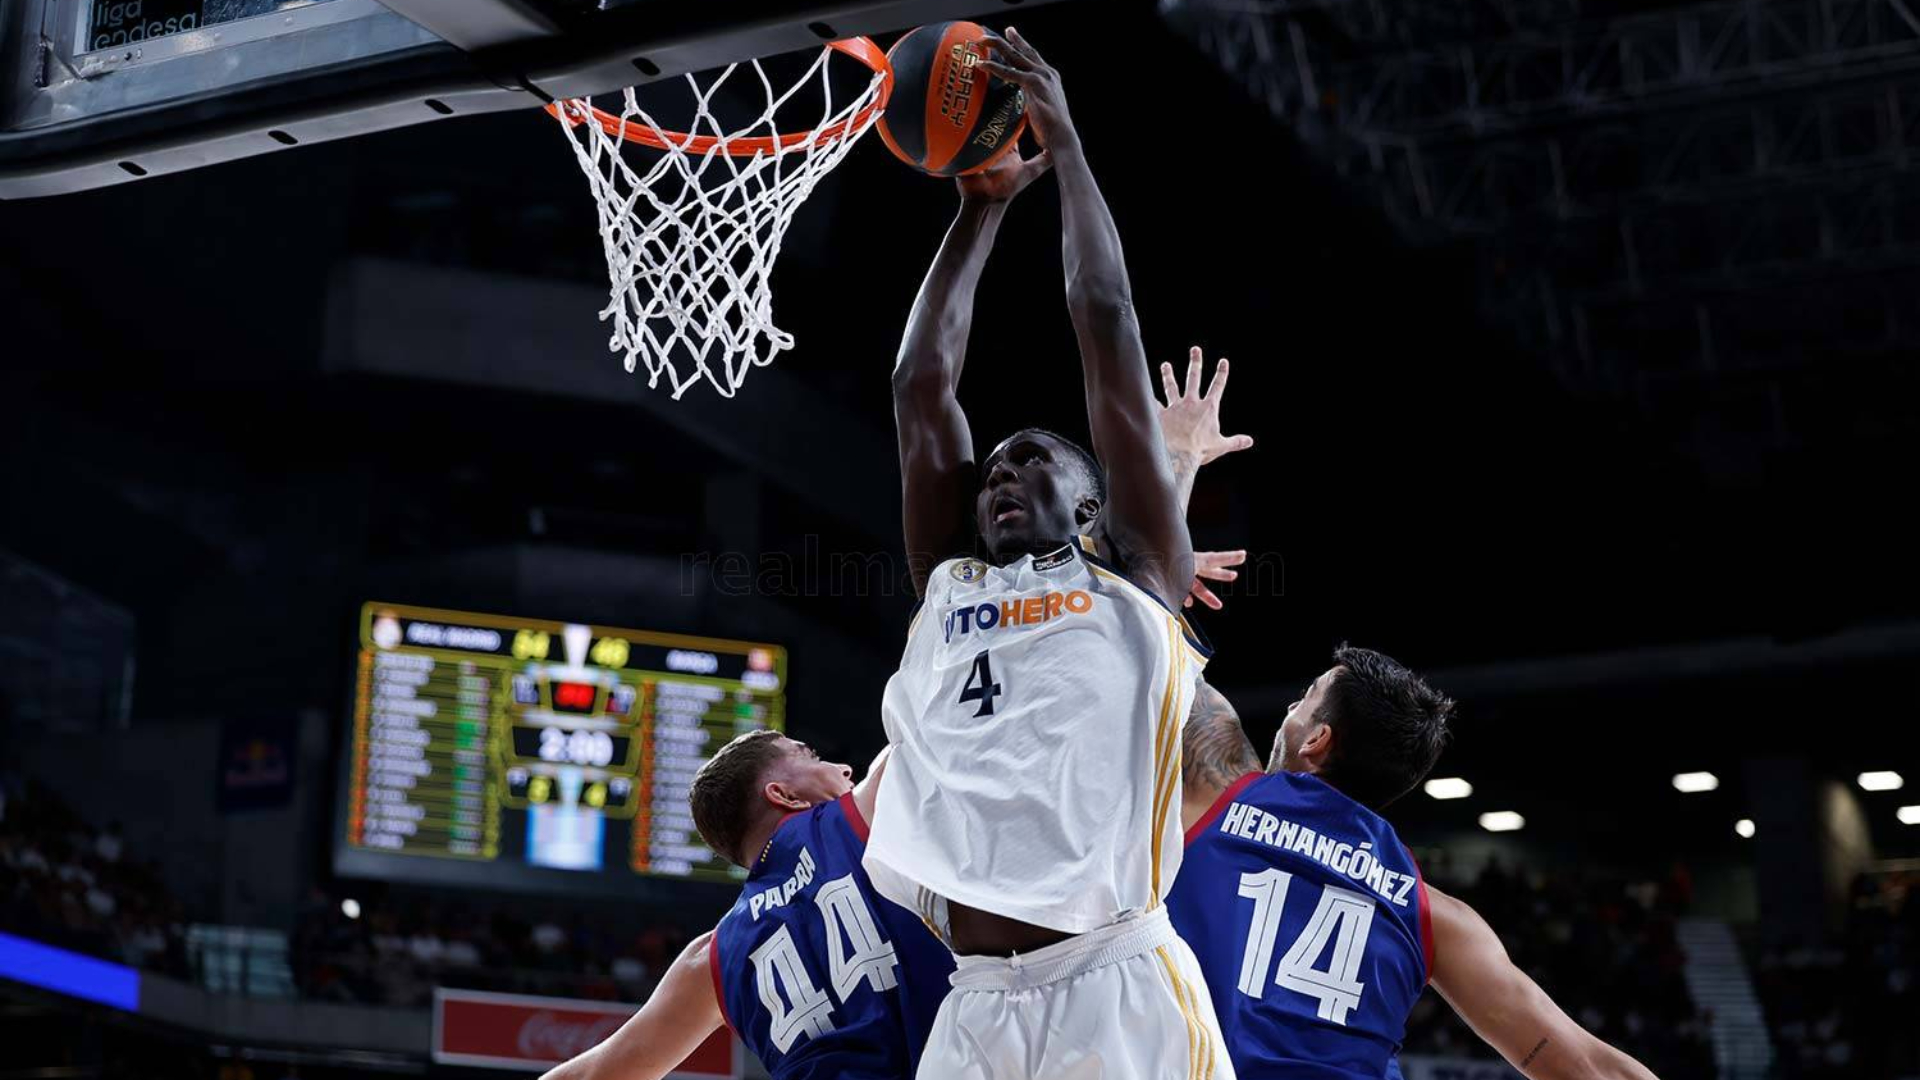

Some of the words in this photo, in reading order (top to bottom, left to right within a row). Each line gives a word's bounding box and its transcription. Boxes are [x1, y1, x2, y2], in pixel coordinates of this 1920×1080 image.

[94, 11, 197, 50] endesa
[97, 0, 142, 27] liga
[958, 649, 1002, 718] 4
[749, 846, 816, 921] PARRA
[1219, 802, 1416, 908] HERNANGÓMEZ
[748, 872, 899, 1056] 44
[1237, 867, 1377, 1027] 14
